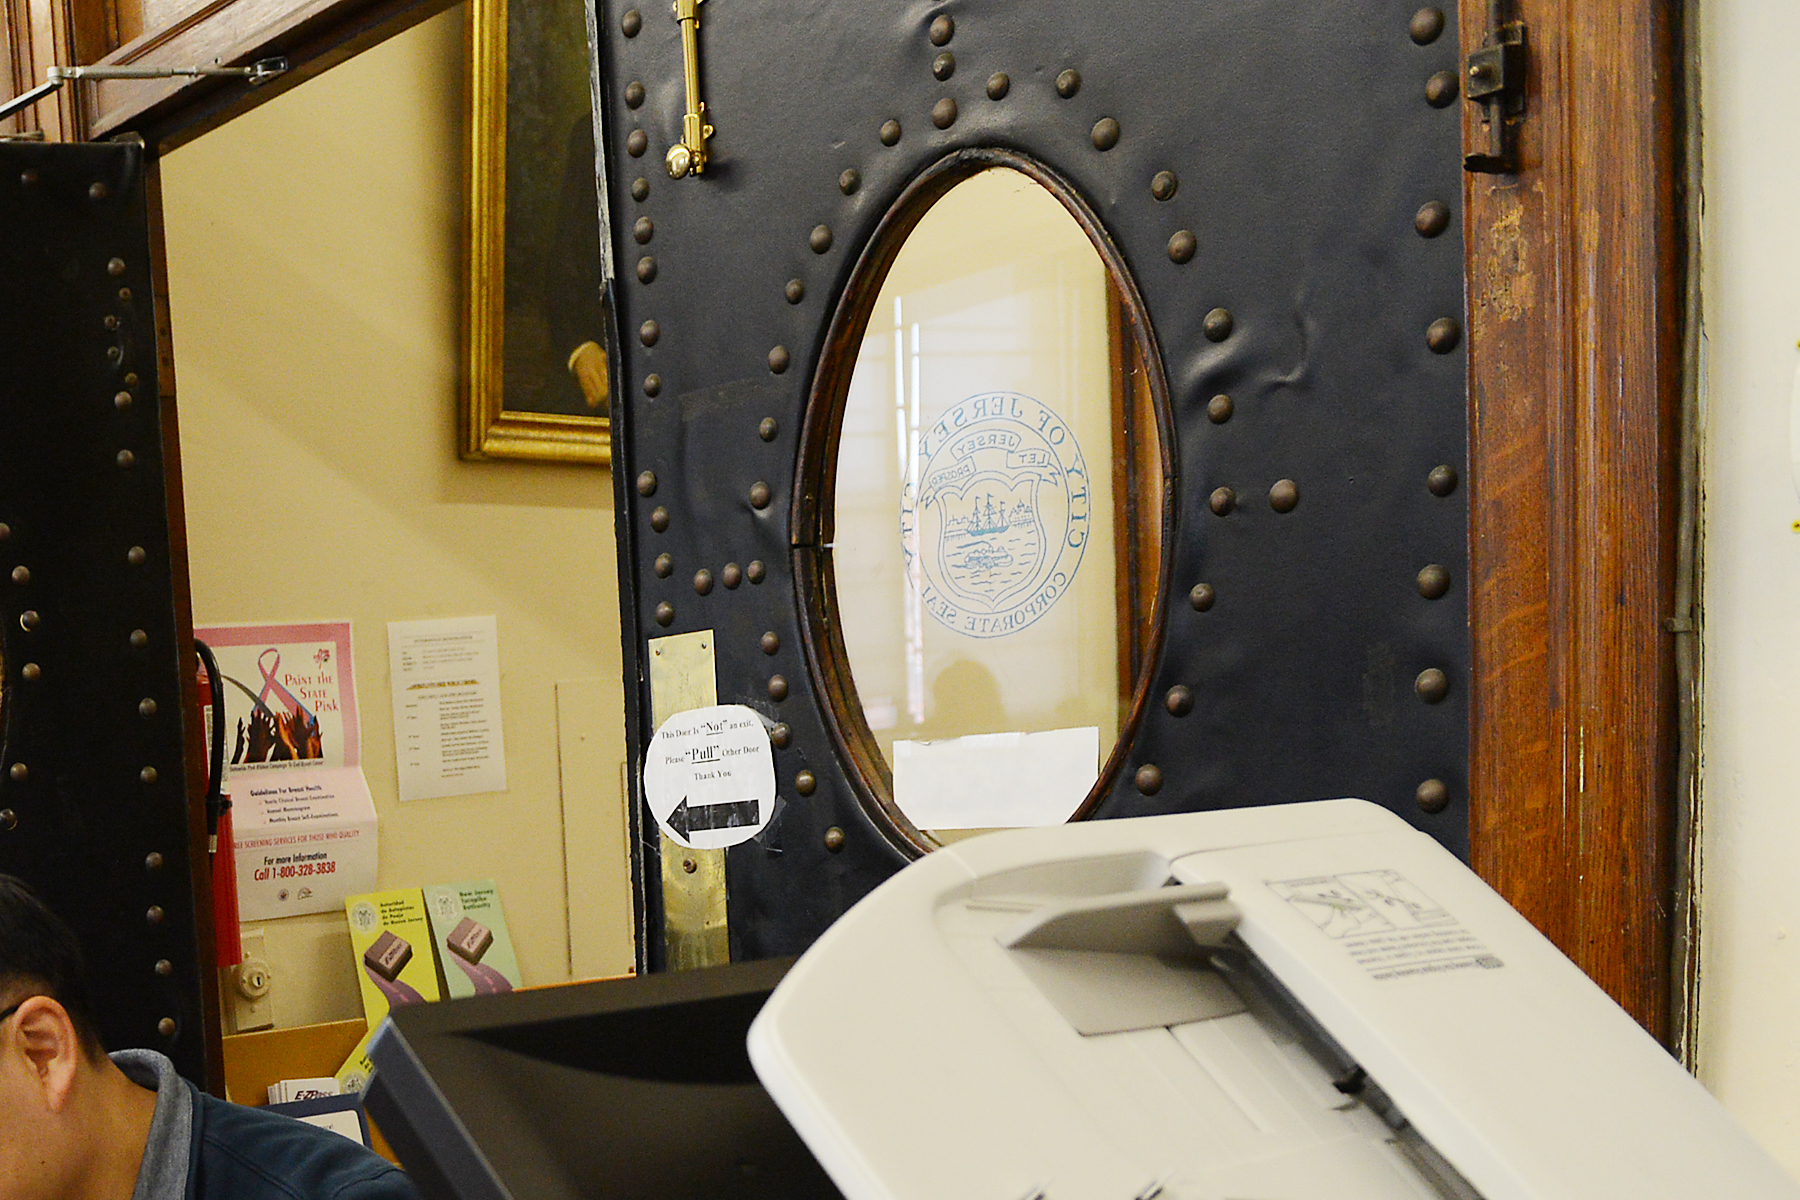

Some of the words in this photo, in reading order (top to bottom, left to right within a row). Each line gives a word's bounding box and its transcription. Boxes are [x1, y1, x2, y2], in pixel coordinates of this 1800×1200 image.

[661, 729, 675, 740] This
[675, 728, 691, 738] Door
[729, 722, 738, 730] an
[665, 756, 685, 765] Please
[722, 747, 742, 757] Other
[743, 746, 760, 755] Door
[694, 771, 716, 781] Thank
[717, 769, 733, 779] You
[264, 856, 274, 866] For
[275, 856, 292, 865] more
[292, 852, 328, 864] Information
[254, 867, 270, 881] Call
[272, 861, 336, 879] 1-800-328-3838
